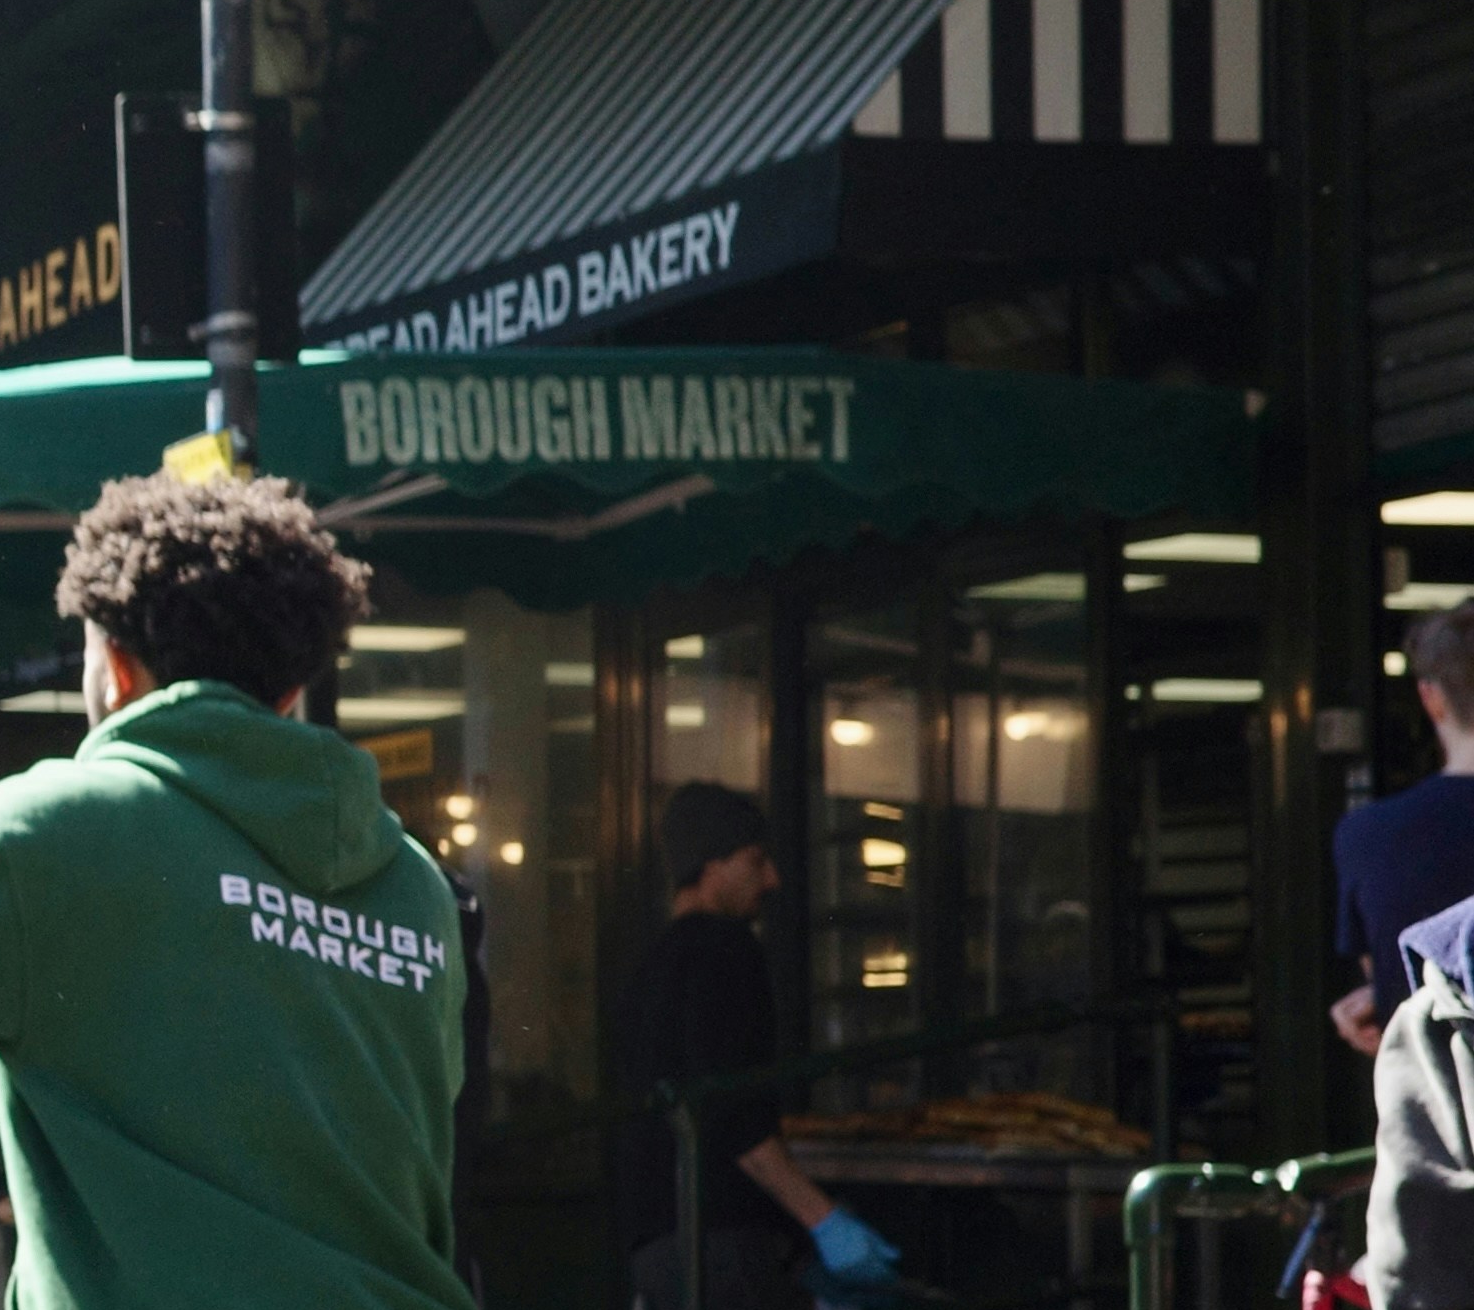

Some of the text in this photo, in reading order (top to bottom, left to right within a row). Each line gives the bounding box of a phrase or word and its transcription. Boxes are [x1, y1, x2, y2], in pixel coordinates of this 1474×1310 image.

[444, 263, 570, 353] AHEAD
[578, 200, 741, 318] BAKERY
[340, 374, 855, 467] BOROUGH MARKET
[219, 872, 446, 971] BOROUGH
[250, 911, 433, 993] MARKET
